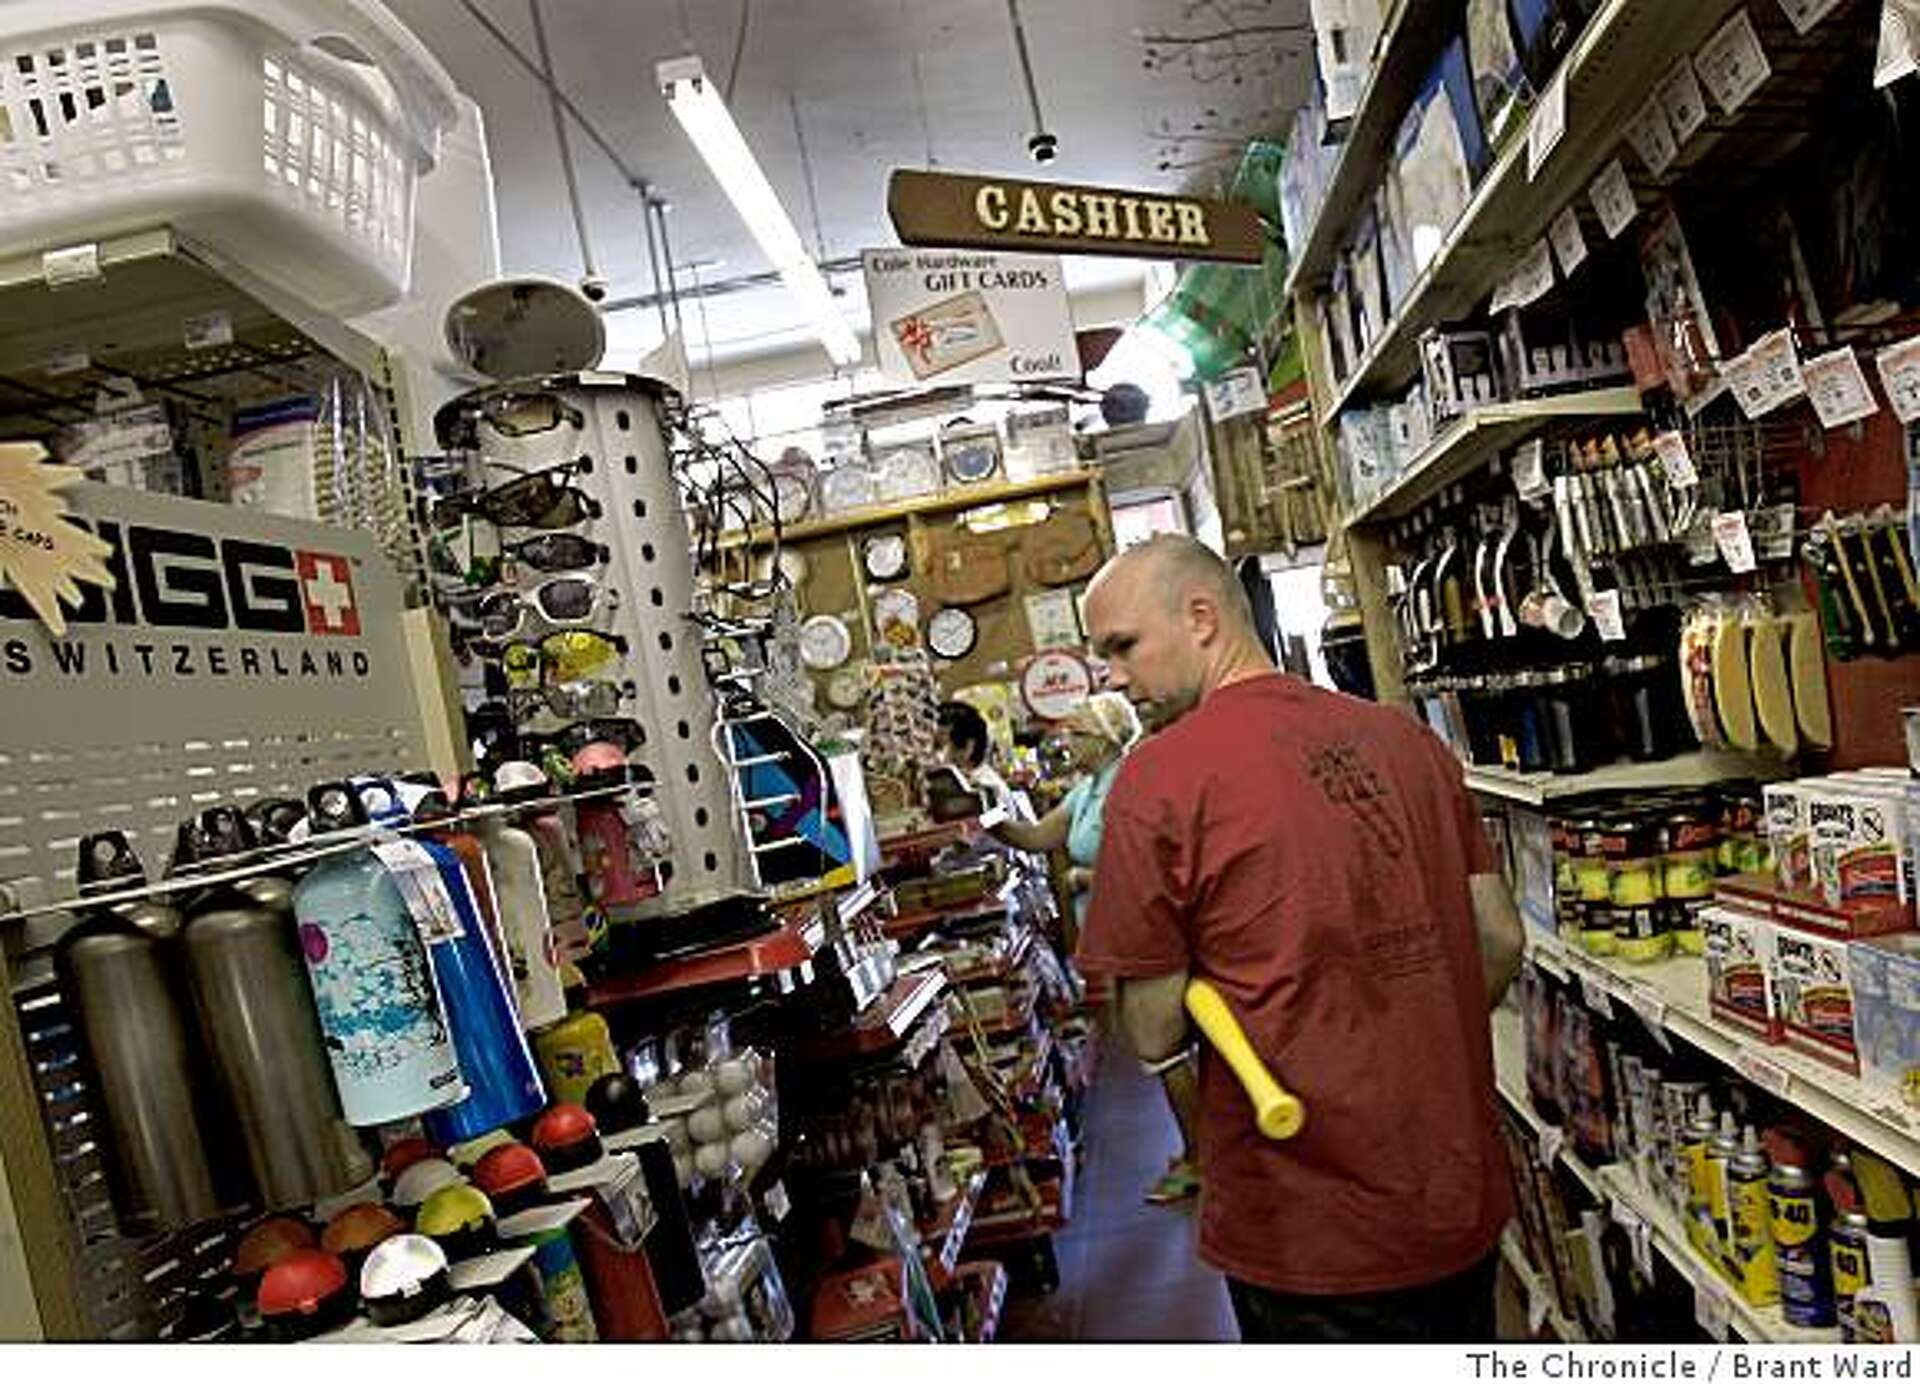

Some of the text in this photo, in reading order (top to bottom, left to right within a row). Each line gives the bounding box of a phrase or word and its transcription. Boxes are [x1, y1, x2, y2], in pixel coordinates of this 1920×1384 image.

[976, 186, 1209, 244] CASHIER
[926, 269, 1048, 292] GIFT CARDS
[5, 641, 370, 678] SWITZERLAND
